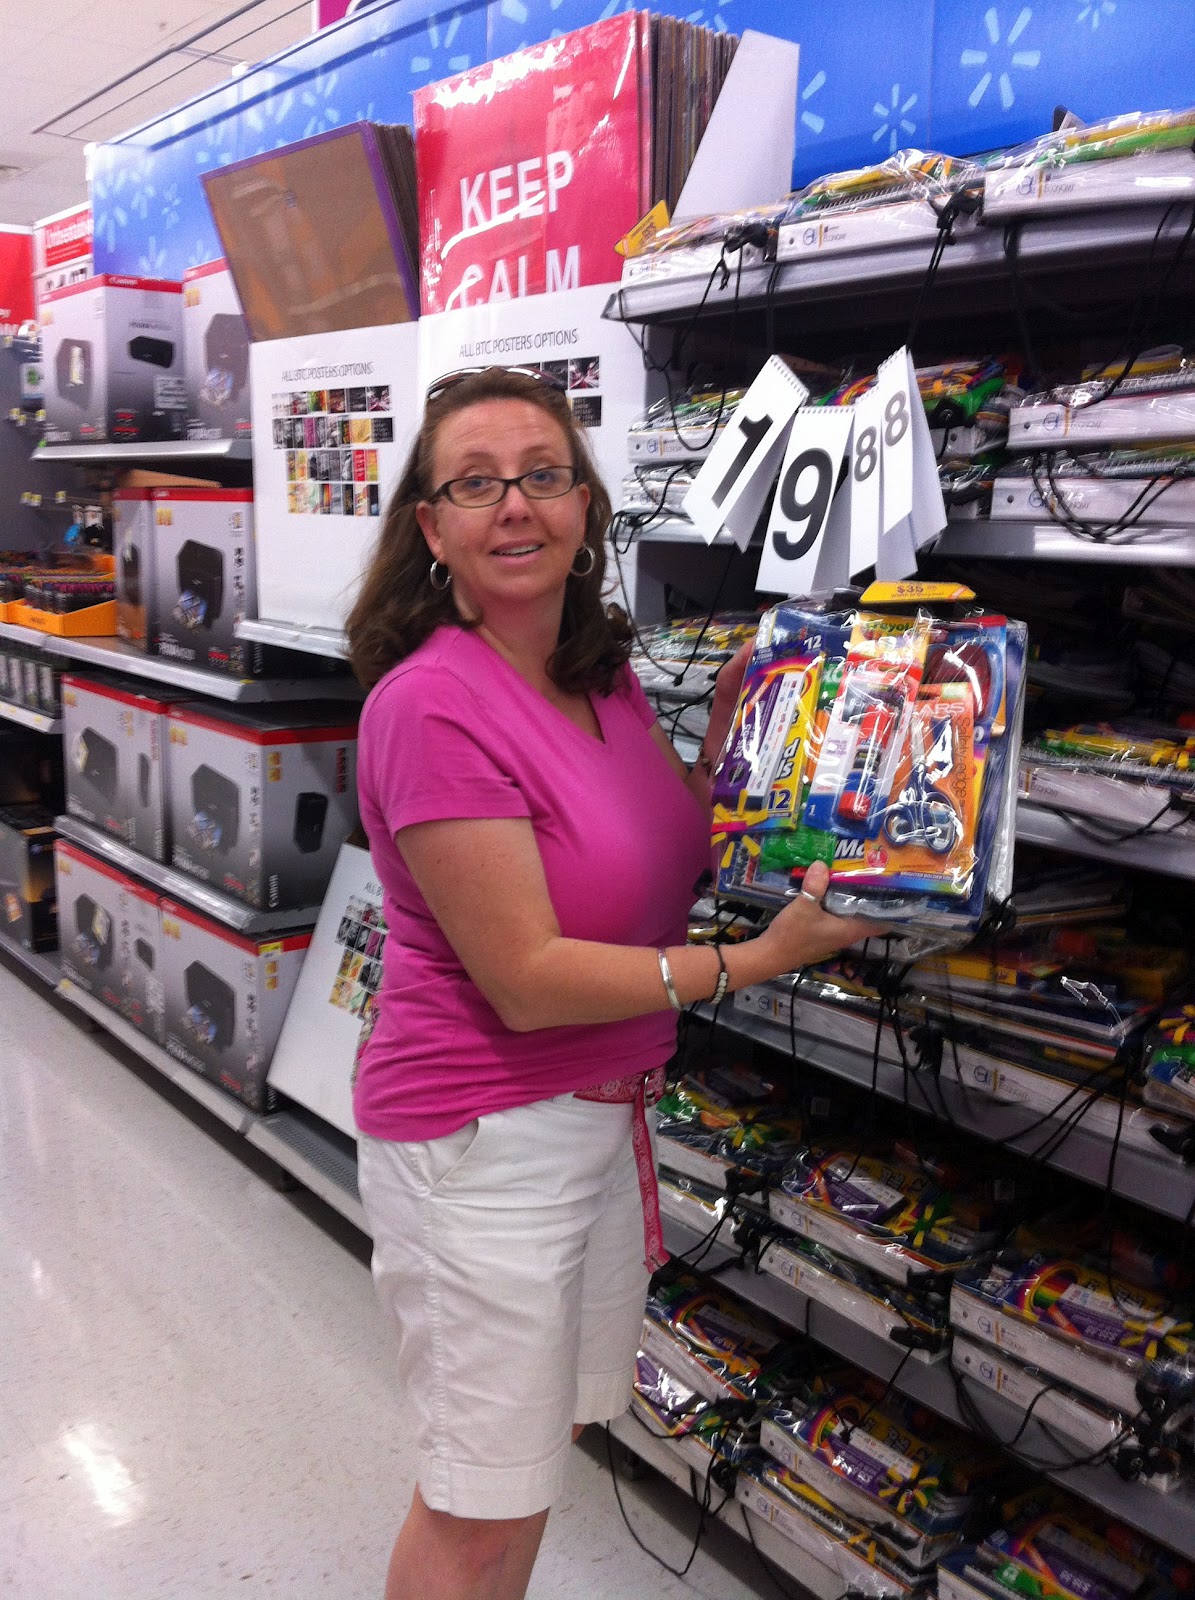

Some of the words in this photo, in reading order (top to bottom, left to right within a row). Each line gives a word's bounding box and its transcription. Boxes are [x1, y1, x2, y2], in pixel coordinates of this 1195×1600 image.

[459, 150, 574, 231] KEEP
[459, 345, 475, 358] ALL
[475, 340, 492, 356] BTC
[493, 334, 532, 353] POSTERS
[533, 328, 578, 348] OPTIONS
[896, 583, 924, 594] $35
[767, 788, 791, 811] 12
